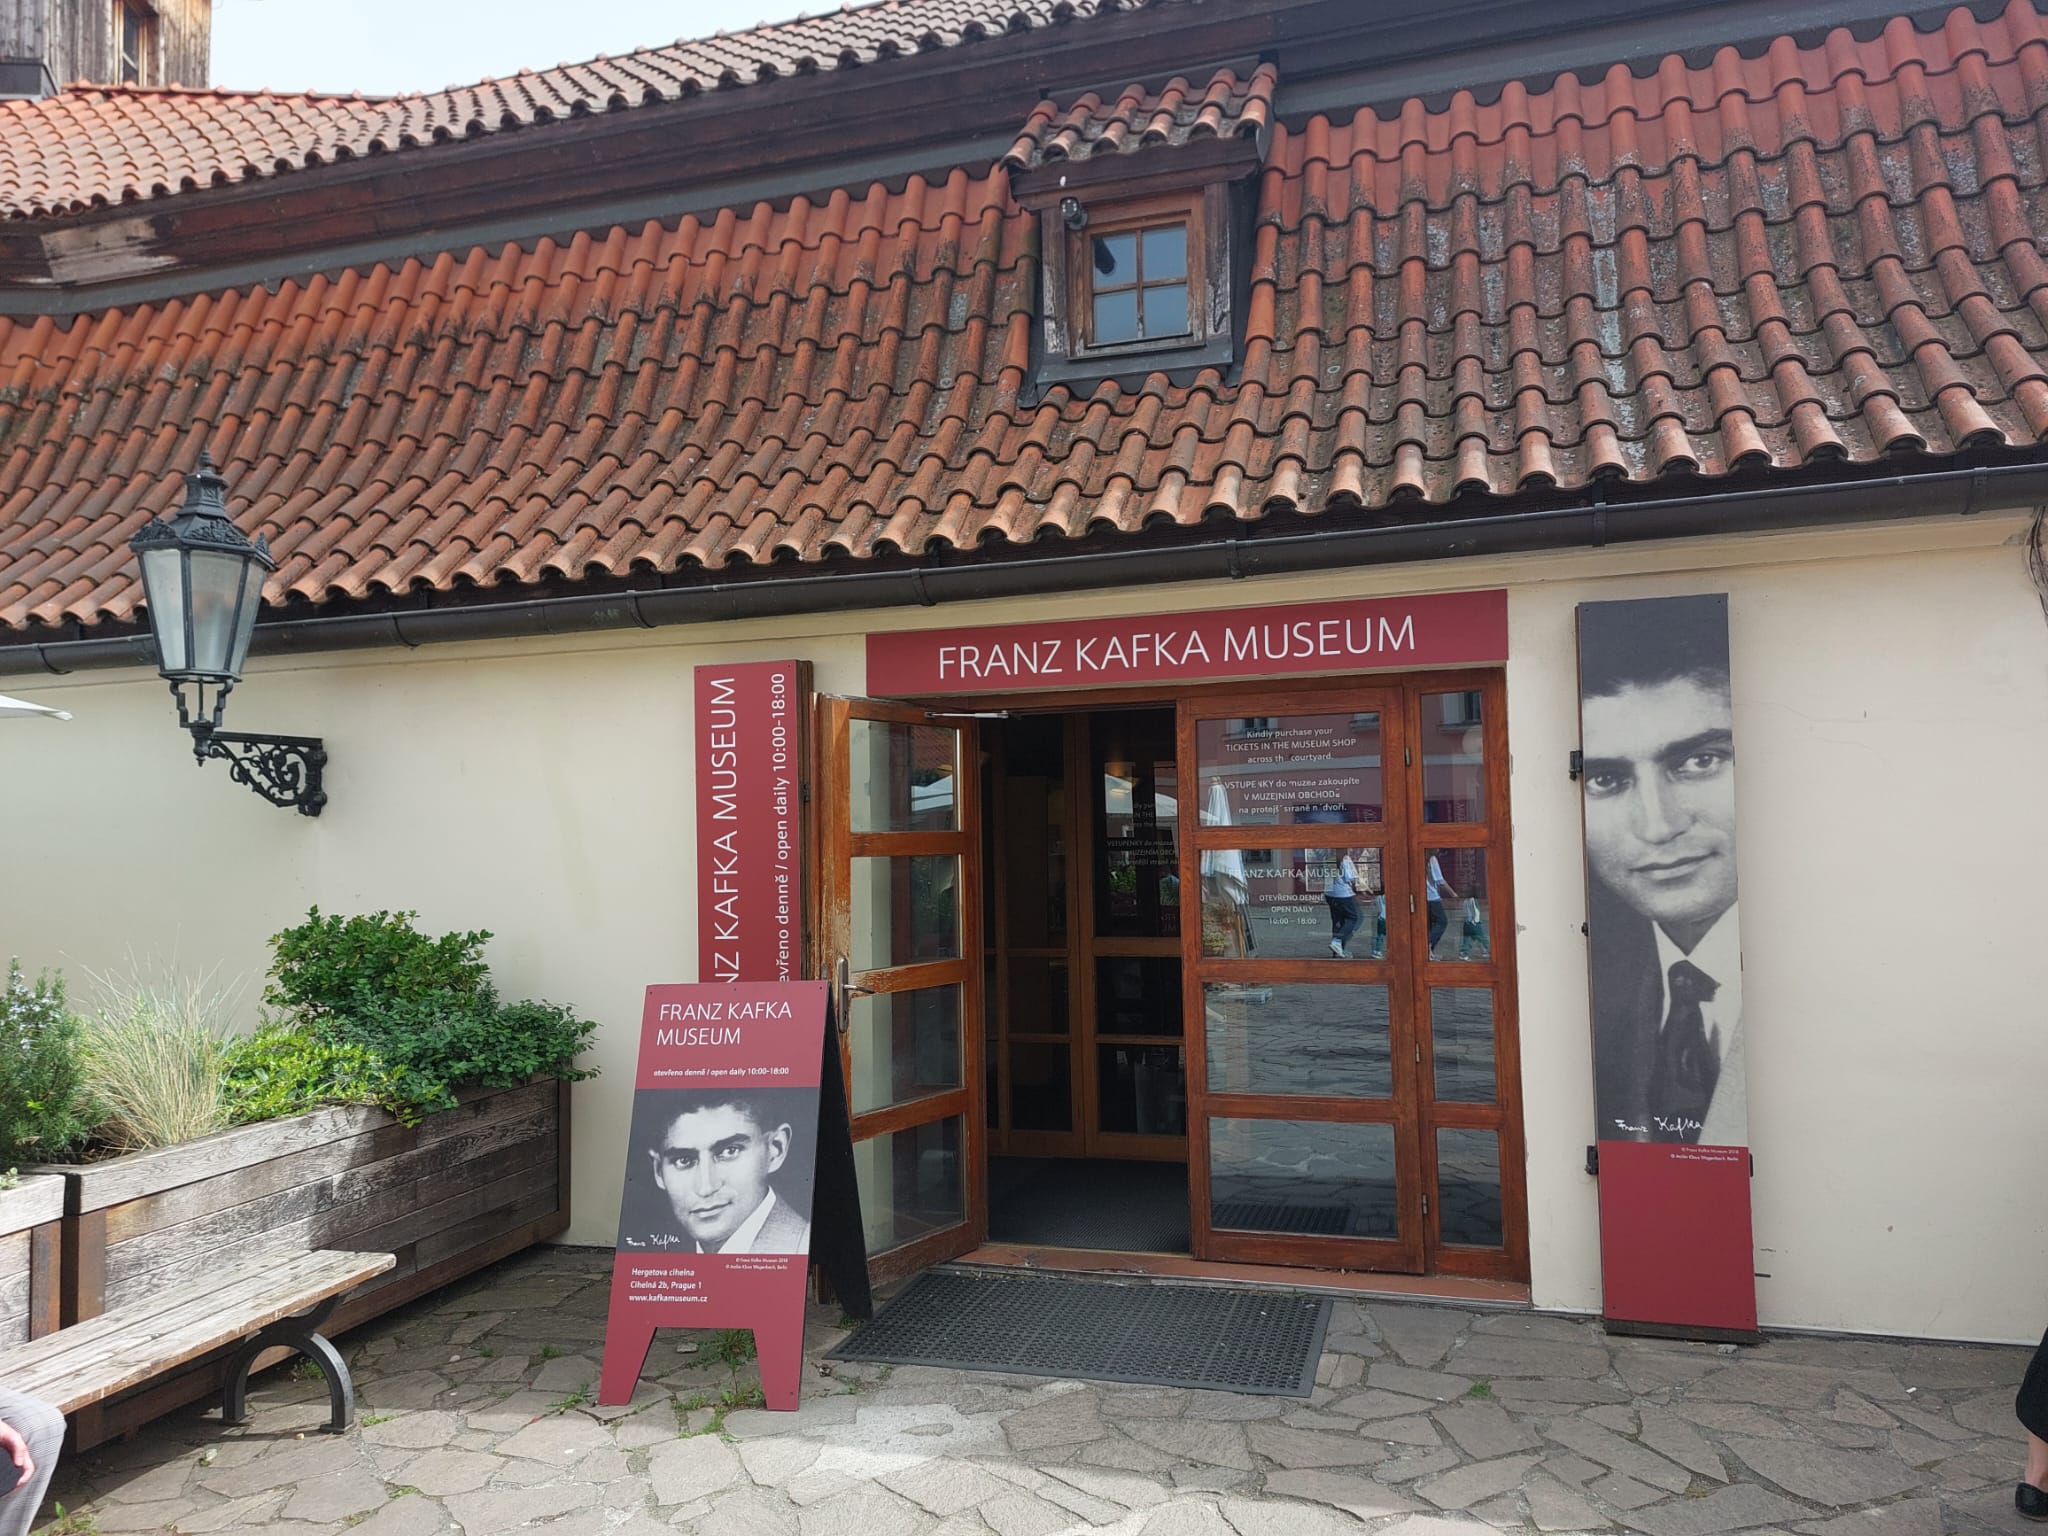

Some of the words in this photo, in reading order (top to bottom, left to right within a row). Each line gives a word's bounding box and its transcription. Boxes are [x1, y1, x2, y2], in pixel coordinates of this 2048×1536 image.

[938, 639, 1063, 680] FRANZ
[1076, 630, 1210, 672] KAFKA
[1223, 615, 1416, 662] MUSEUM
[770, 673, 787, 772] 10:00-18:00
[1247, 730, 1273, 739] Kindly
[1275, 729, 1312, 738] purchase
[1314, 728, 1333, 737] your
[710, 677, 737, 821] MUSEUM
[1225, 743, 1260, 752] TICKETS
[1261, 742, 1270, 750] IN
[1272, 741, 1289, 750] THE
[1291, 739, 1330, 749] MUSEUM
[1332, 738, 1356, 747] SHOP
[1247, 756, 1273, 764] across
[1276, 780, 1287, 788] do
[773, 777, 790, 815] daily
[777, 820, 791, 861] open
[1266, 868, 1304, 878] KAFKA
[1307, 868, 1345, 878] MUSEU
[712, 829, 740, 940] KAFKA
[774, 875, 789, 925] denně
[1271, 905, 1291, 913] OPEN
[1292, 905, 1314, 913] DAILY
[776, 928, 790, 983] evřeno
[660, 1002, 722, 1021] FRANZ
[728, 1001, 792, 1019] KAFKA
[656, 1027, 740, 1046] MUSEUM
[710, 1069, 728, 1077] open
[729, 1067, 746, 1077] daily
[747, 1067, 789, 1075] 10:00-18:00
[631, 1267, 668, 1278] Hergetova
[668, 1267, 695, 1277] cihelna
[630, 1280, 657, 1289] Cihelná
[671, 1281, 696, 1291] Prague
[628, 1293, 708, 1303] www.kafkamuseum.cz
